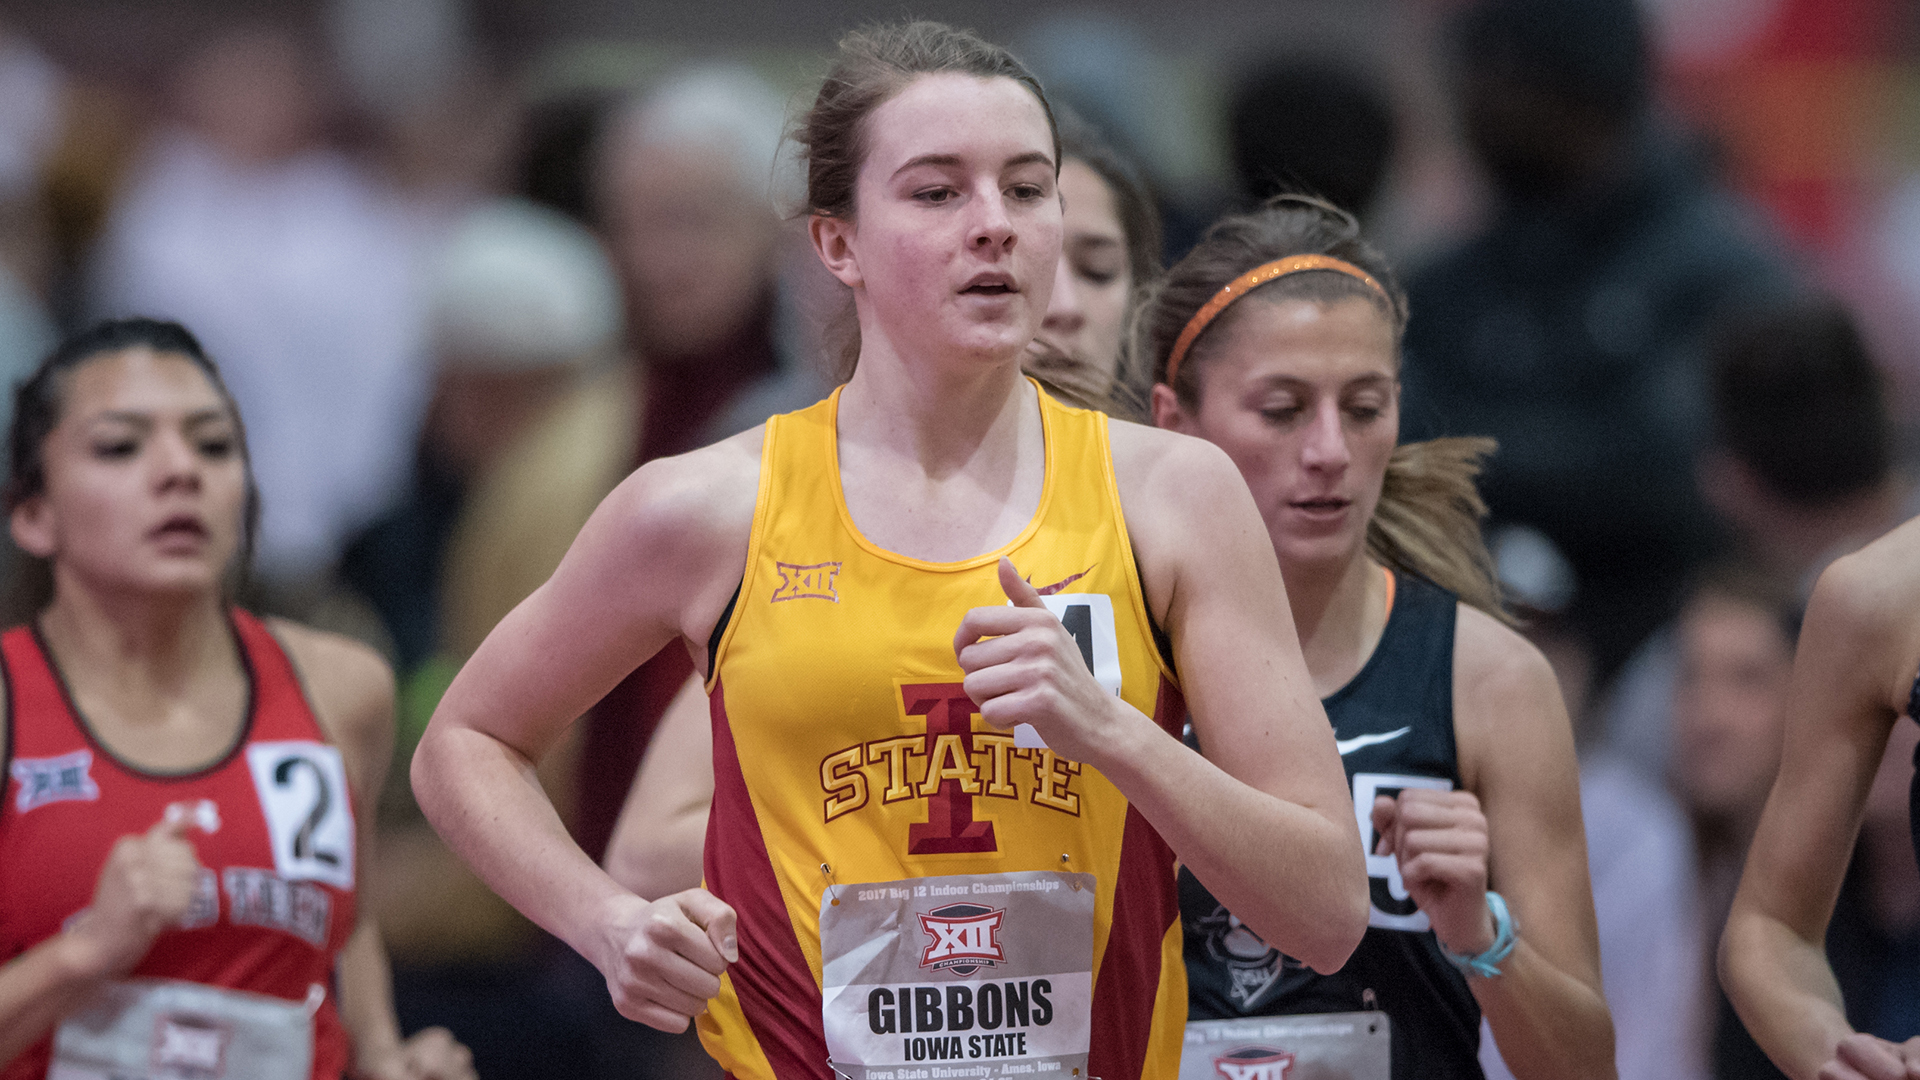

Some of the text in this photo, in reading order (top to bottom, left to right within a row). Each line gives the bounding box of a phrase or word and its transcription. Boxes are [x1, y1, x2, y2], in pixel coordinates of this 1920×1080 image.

[819, 733, 1082, 824] STATE
[273, 756, 340, 866] 2
[858, 880, 1060, 901] 2017 Big 12 Indoor Championships
[938, 958, 990, 969] CHAMPIONSHIP
[868, 979, 1054, 1034] GIBBONS
[904, 1032, 1026, 1061] IOWA STATE
[865, 1069, 894, 1080] Iowa
[897, 1068, 929, 1079] State
[931, 1065, 991, 1079] University
[1001, 1063, 1035, 1075] Ames,
[1037, 1060, 1061, 1071] Iowa
